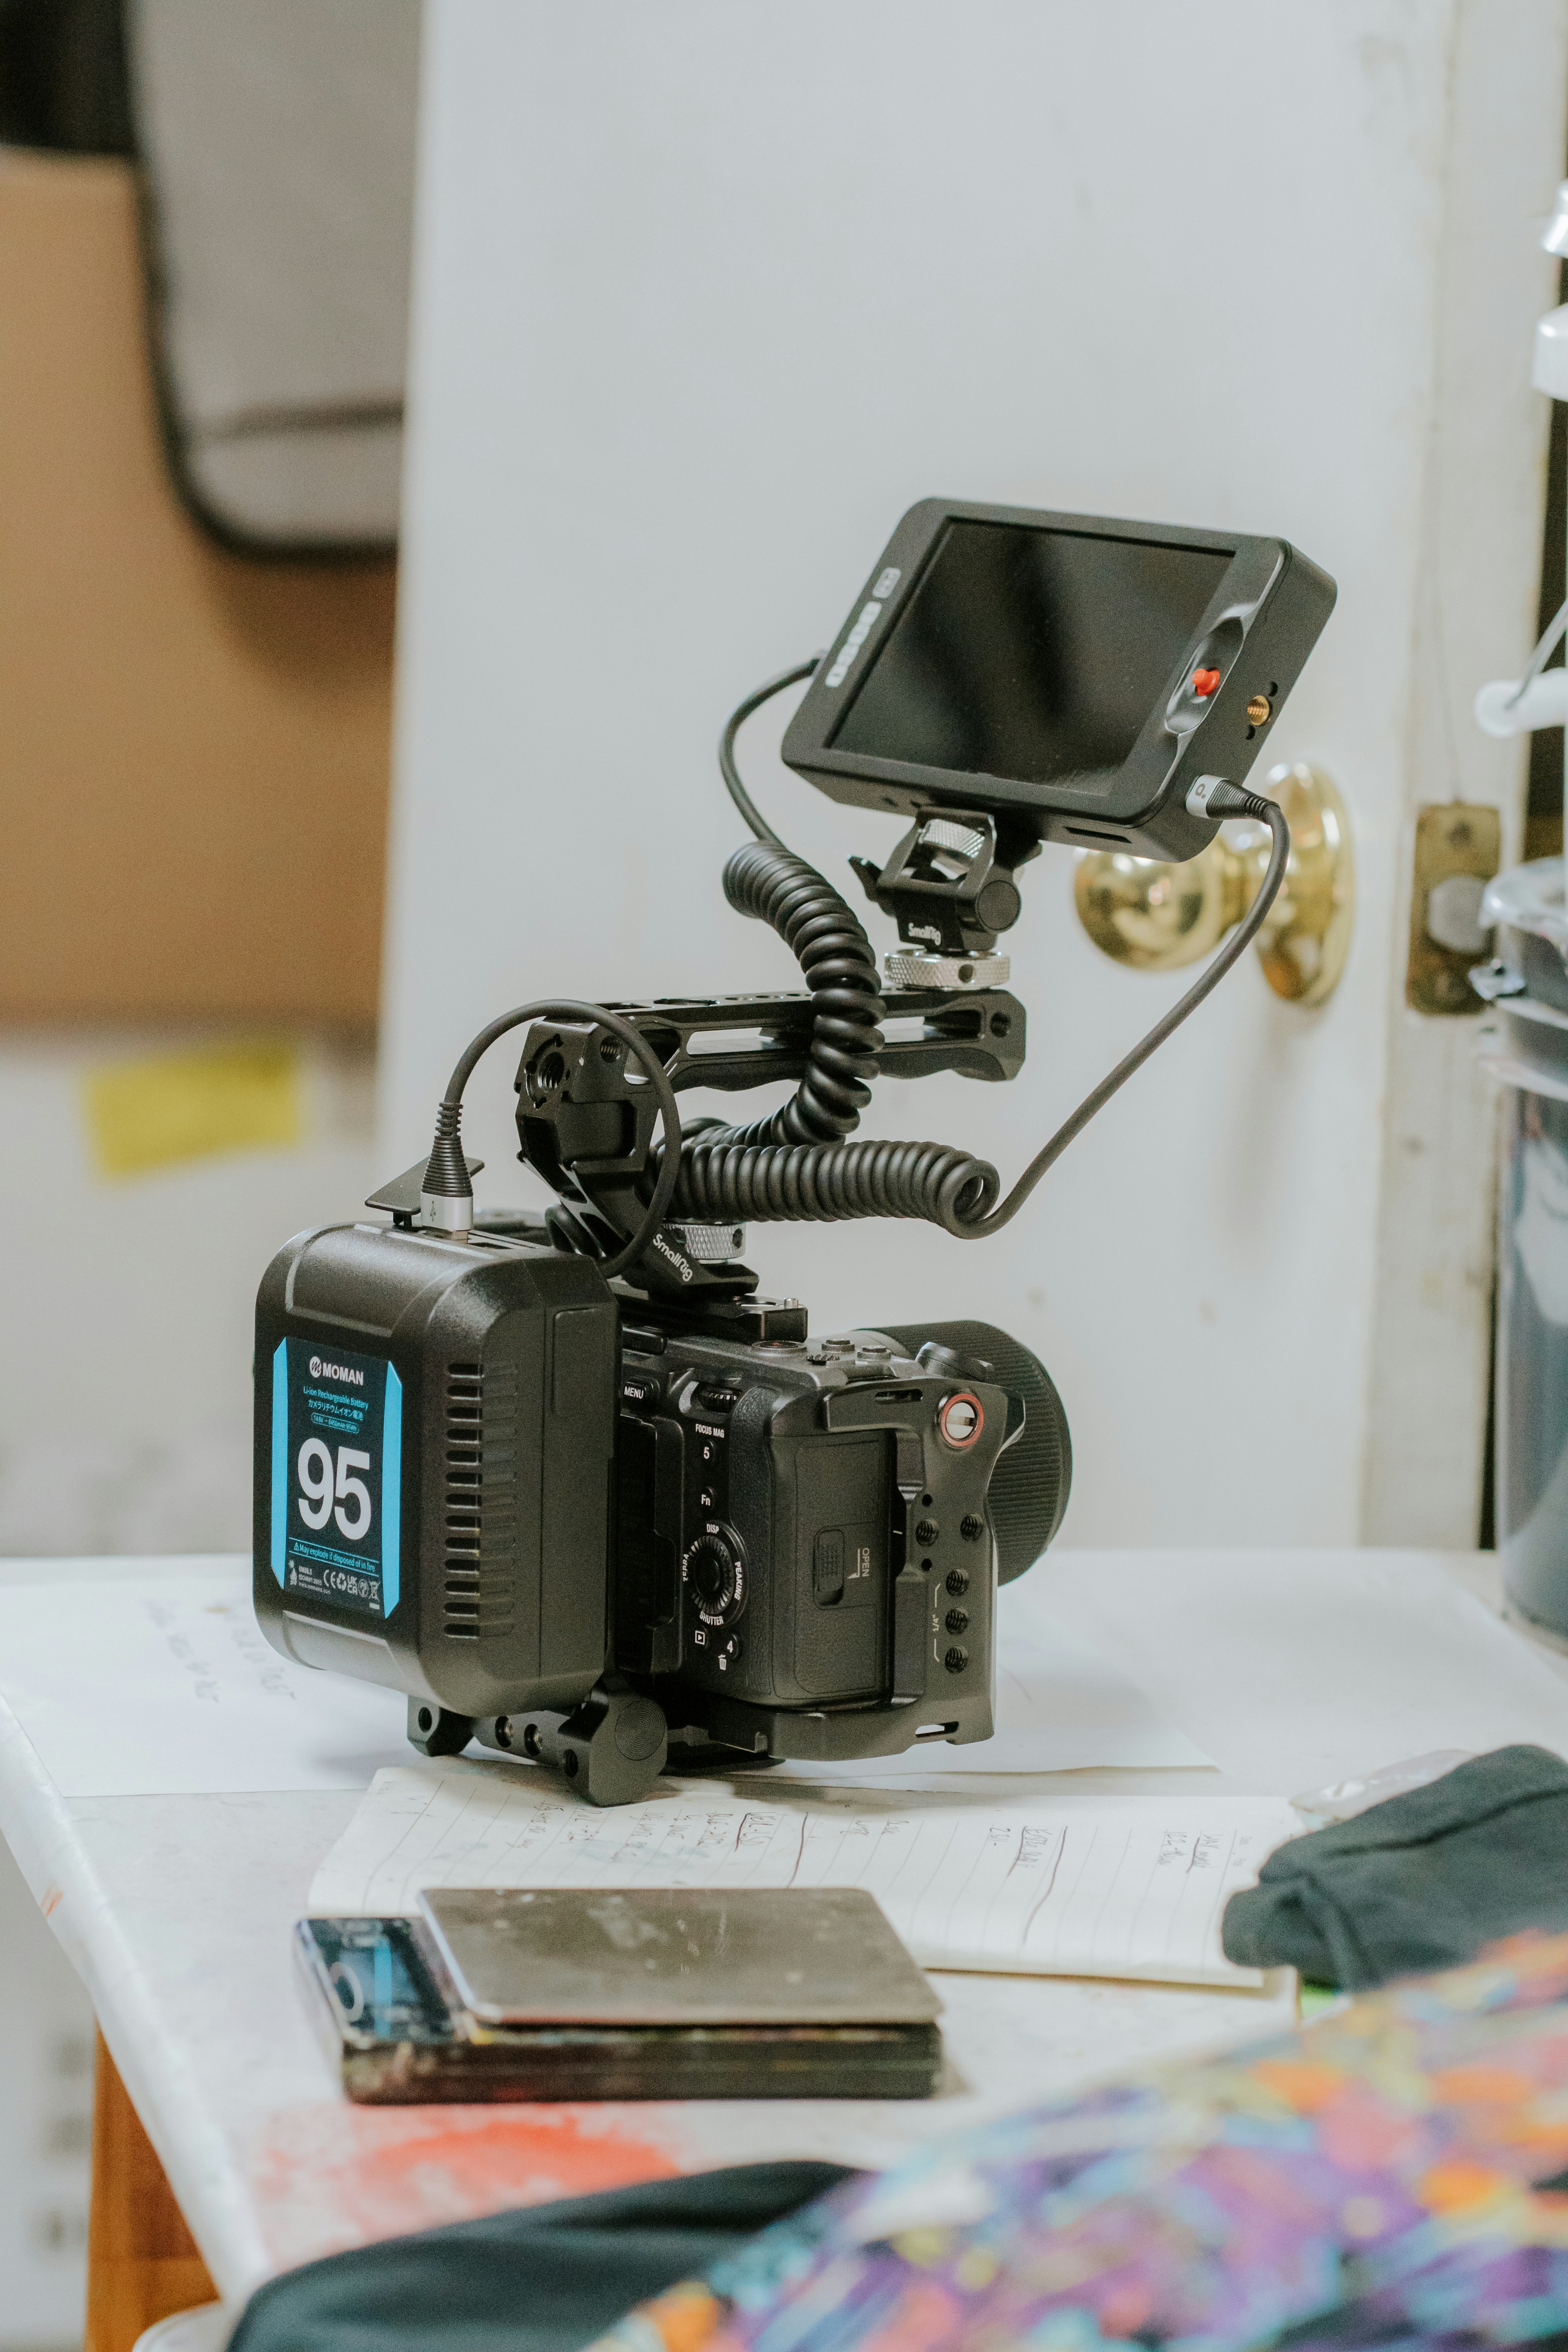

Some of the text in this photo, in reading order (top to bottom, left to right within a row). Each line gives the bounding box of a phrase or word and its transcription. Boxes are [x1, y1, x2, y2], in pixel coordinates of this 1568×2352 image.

[653, 1233, 693, 1282] SmallRig
[323, 1362, 364, 1386] MOMAN
[303, 1386, 369, 1411] Li-ion Rechargeable Battery
[624, 1386, 644, 1399] MENU
[695, 1423, 724, 1438] FOCUS MAG
[704, 1446, 710, 1459] 5
[298, 1437, 371, 1540] 95
[701, 1494, 710, 1506] Fn
[706, 1523, 719, 1534] DISP
[299, 1544, 310, 1555] May
[310, 1548, 328, 1559] explode
[329, 1552, 333, 1560] if
[333, 1553, 355, 1566] disposed
[367, 1562, 375, 1572] fire
[734, 1561, 743, 1601] PEAKING
[699, 1610, 724, 1626] SHUTTER
[727, 1640, 733, 1653] 4
